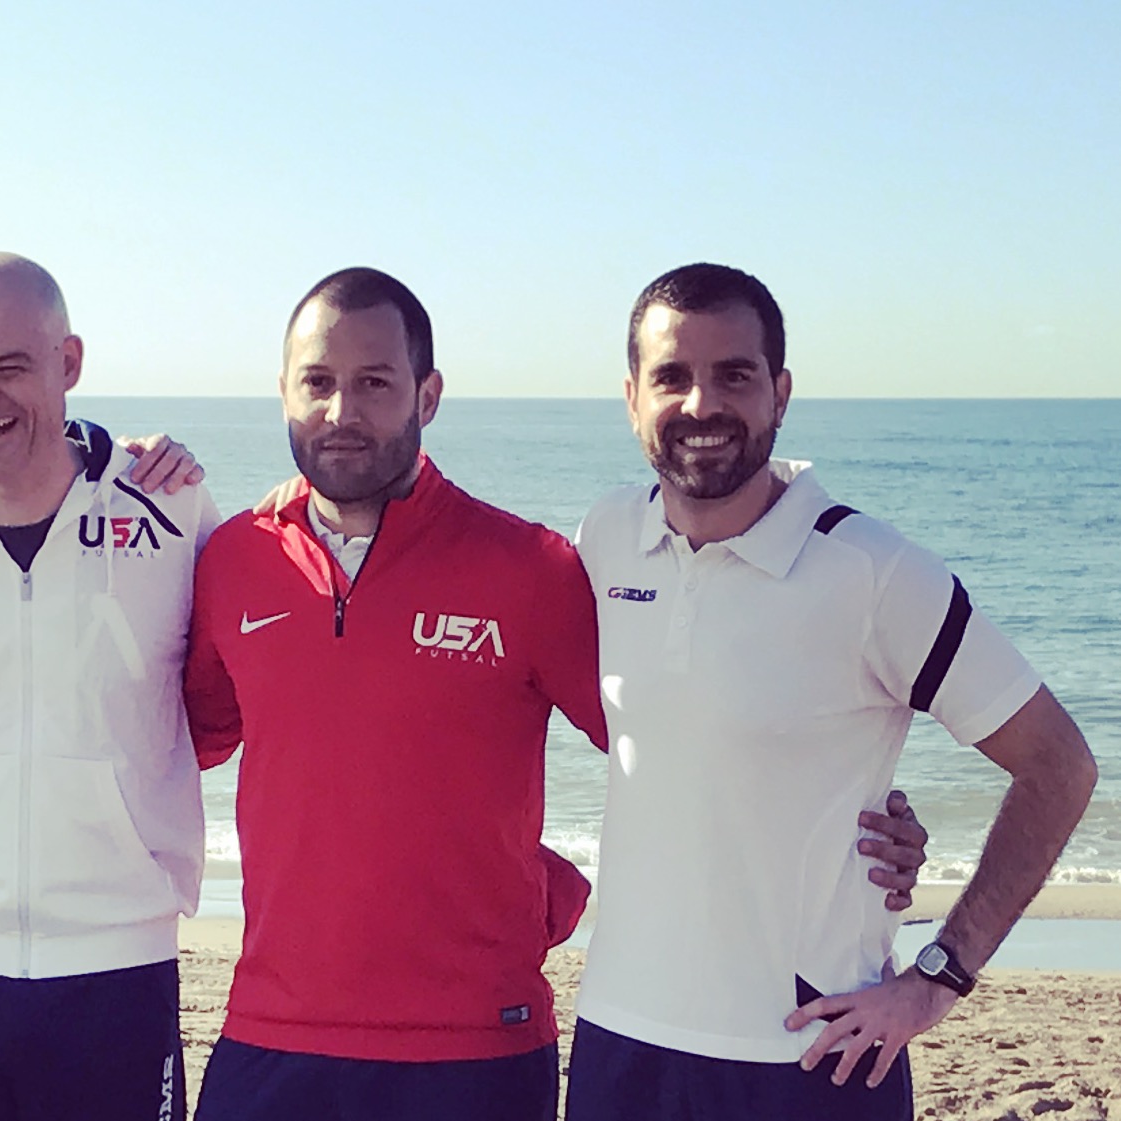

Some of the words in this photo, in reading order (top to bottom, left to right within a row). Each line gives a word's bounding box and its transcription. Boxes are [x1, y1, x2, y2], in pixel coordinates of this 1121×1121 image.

[78, 514, 162, 549] USA
[412, 612, 506, 658] USA
[415, 647, 498, 668] FUTSAL
